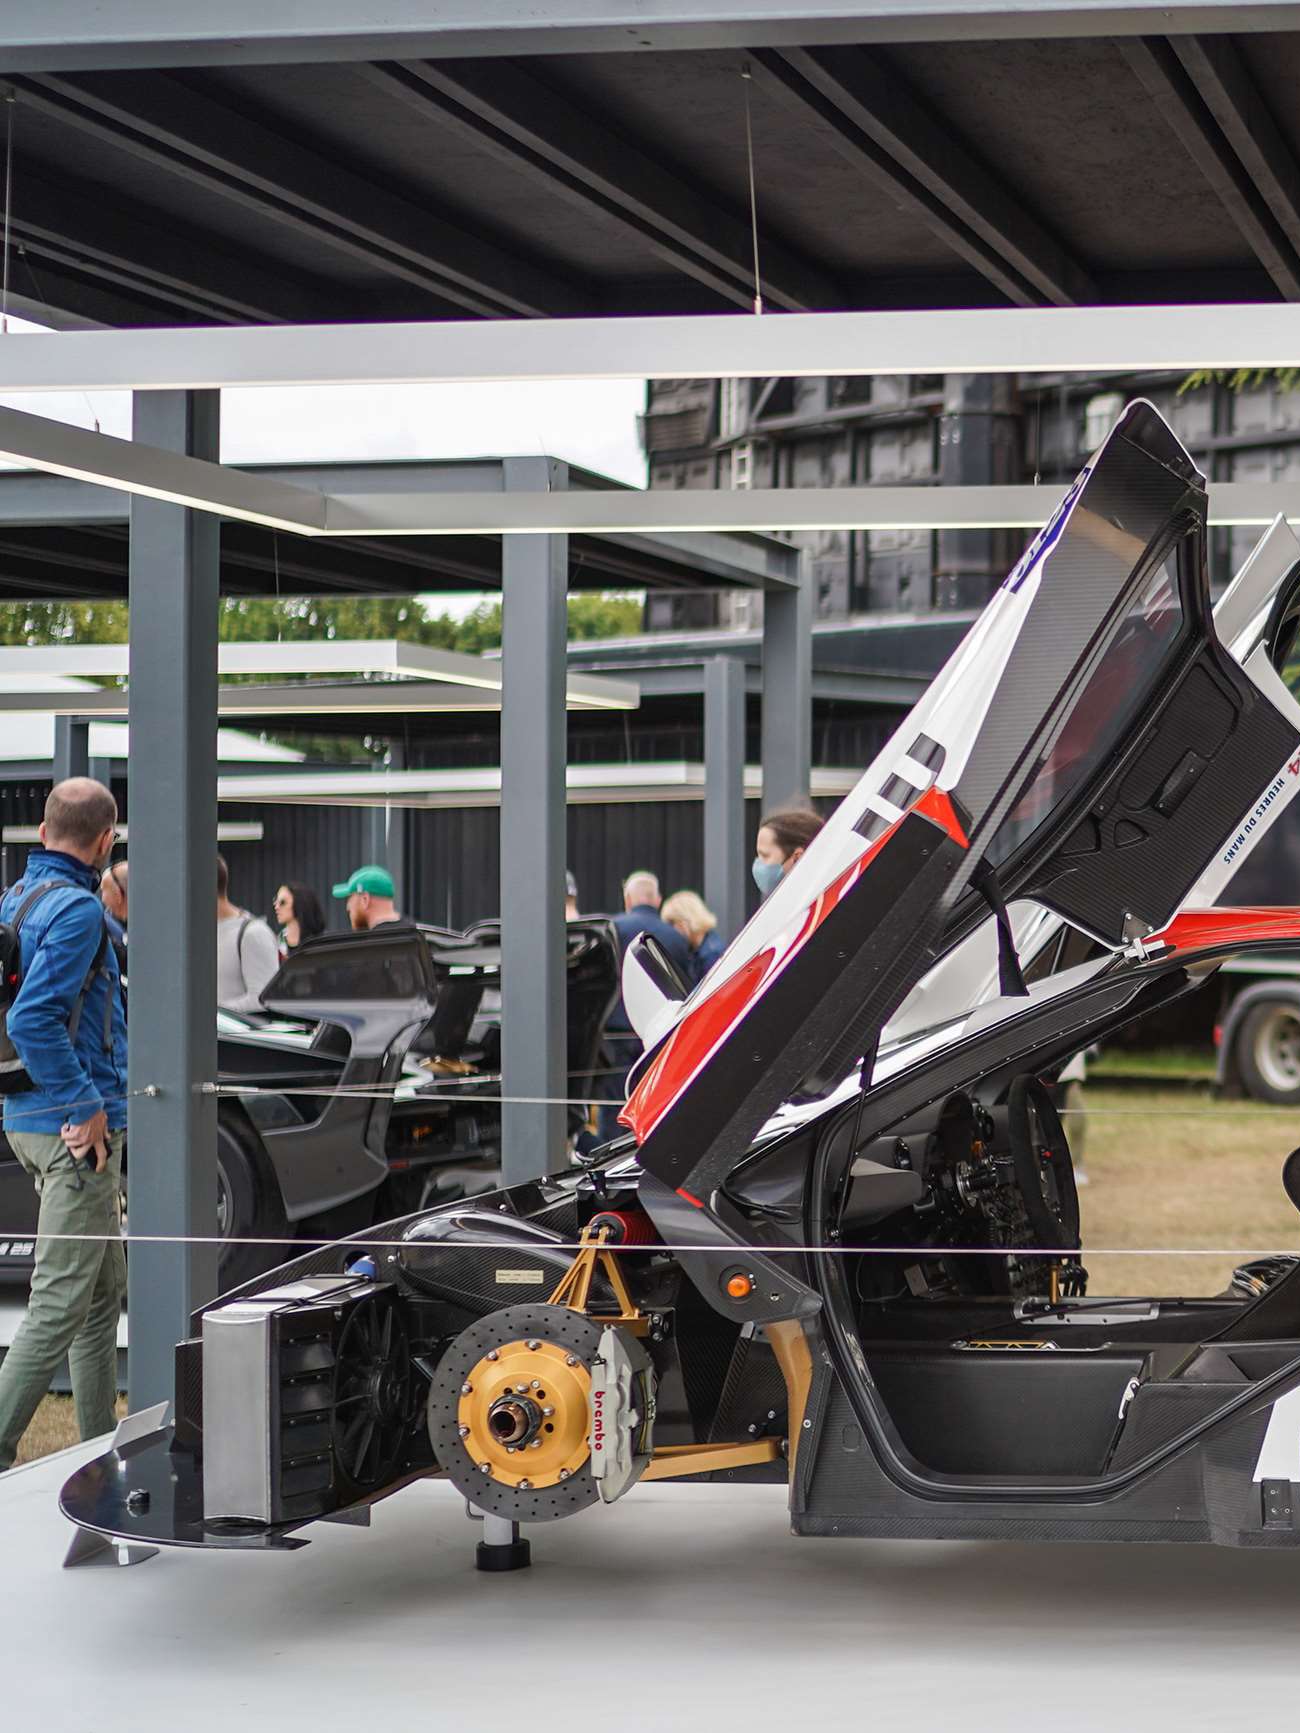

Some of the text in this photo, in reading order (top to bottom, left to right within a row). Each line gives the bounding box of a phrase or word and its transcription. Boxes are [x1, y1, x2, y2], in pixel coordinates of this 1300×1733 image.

[1255, 778, 1285, 818] HEURES
[1244, 819, 1257, 834] DU
[1223, 833, 1246, 865] MANS
[594, 1390, 606, 1451] brembo
